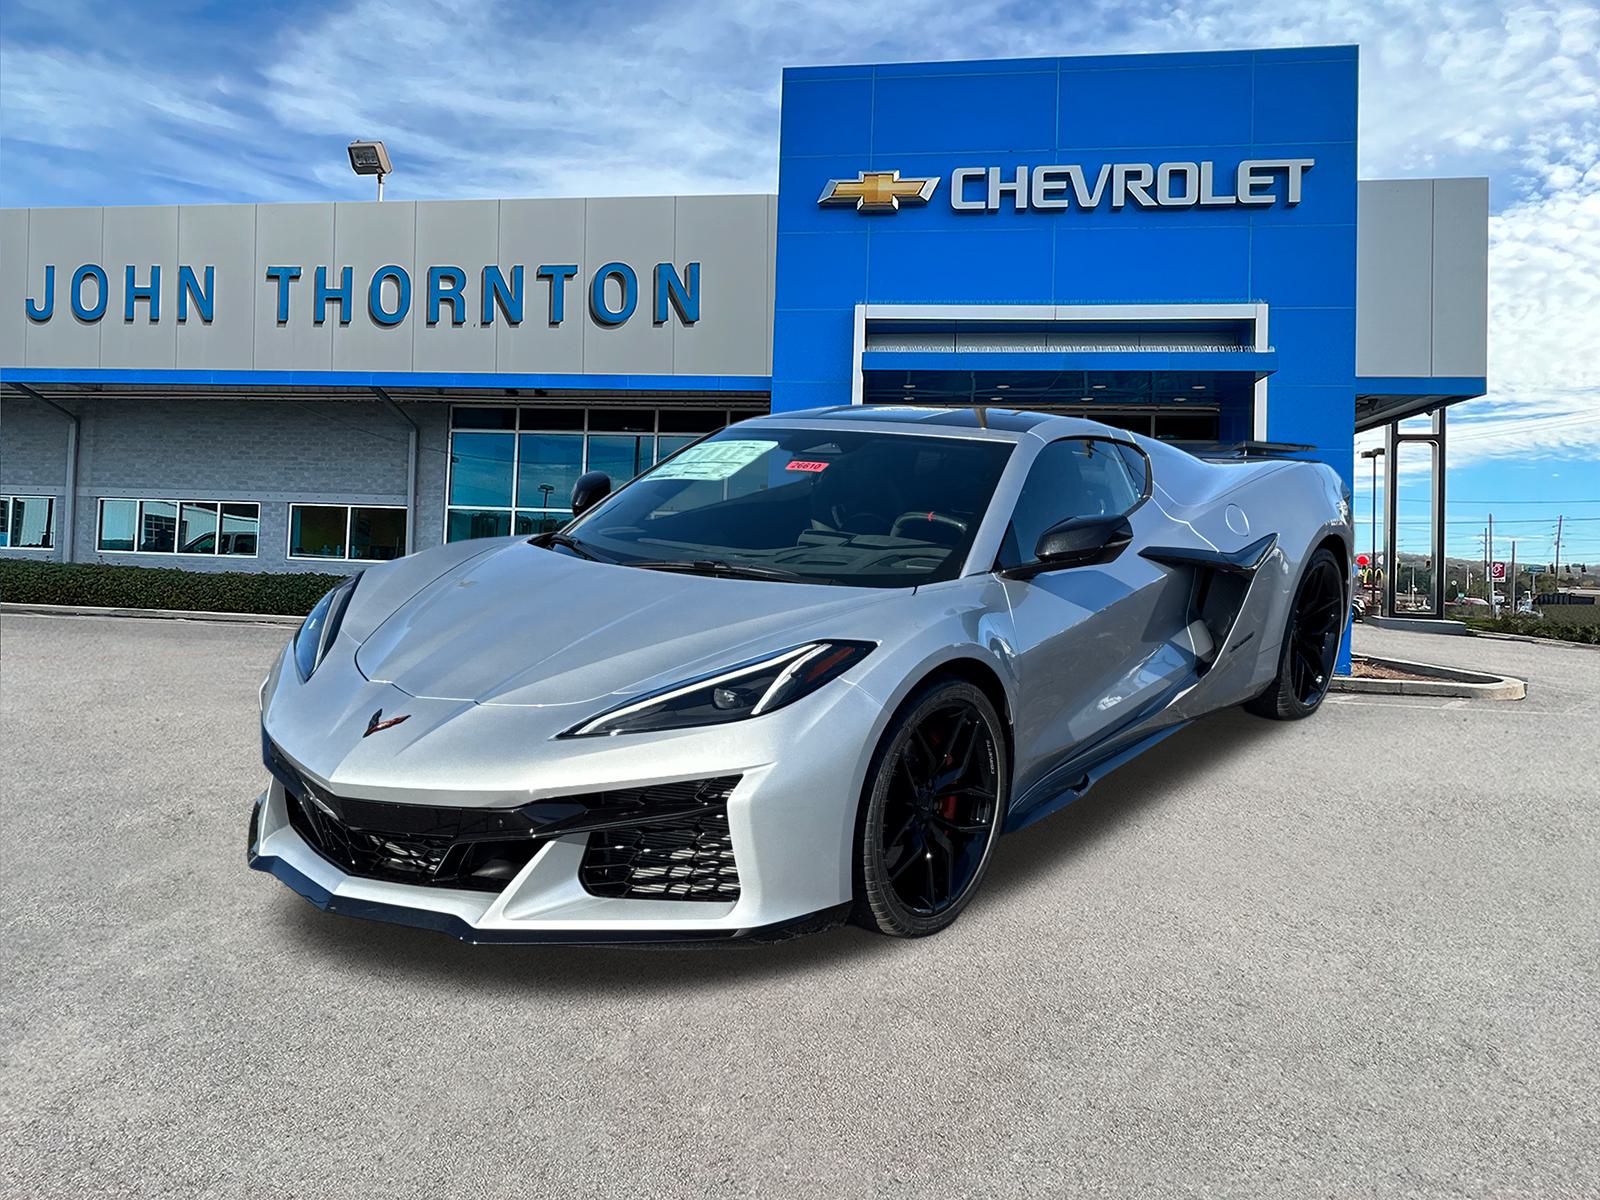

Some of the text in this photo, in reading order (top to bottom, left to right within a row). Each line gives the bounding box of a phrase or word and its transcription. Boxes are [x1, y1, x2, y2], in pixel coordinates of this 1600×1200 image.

[951, 158, 1315, 211] CHEVROLET
[26, 262, 701, 325] JOHN THORNTON
